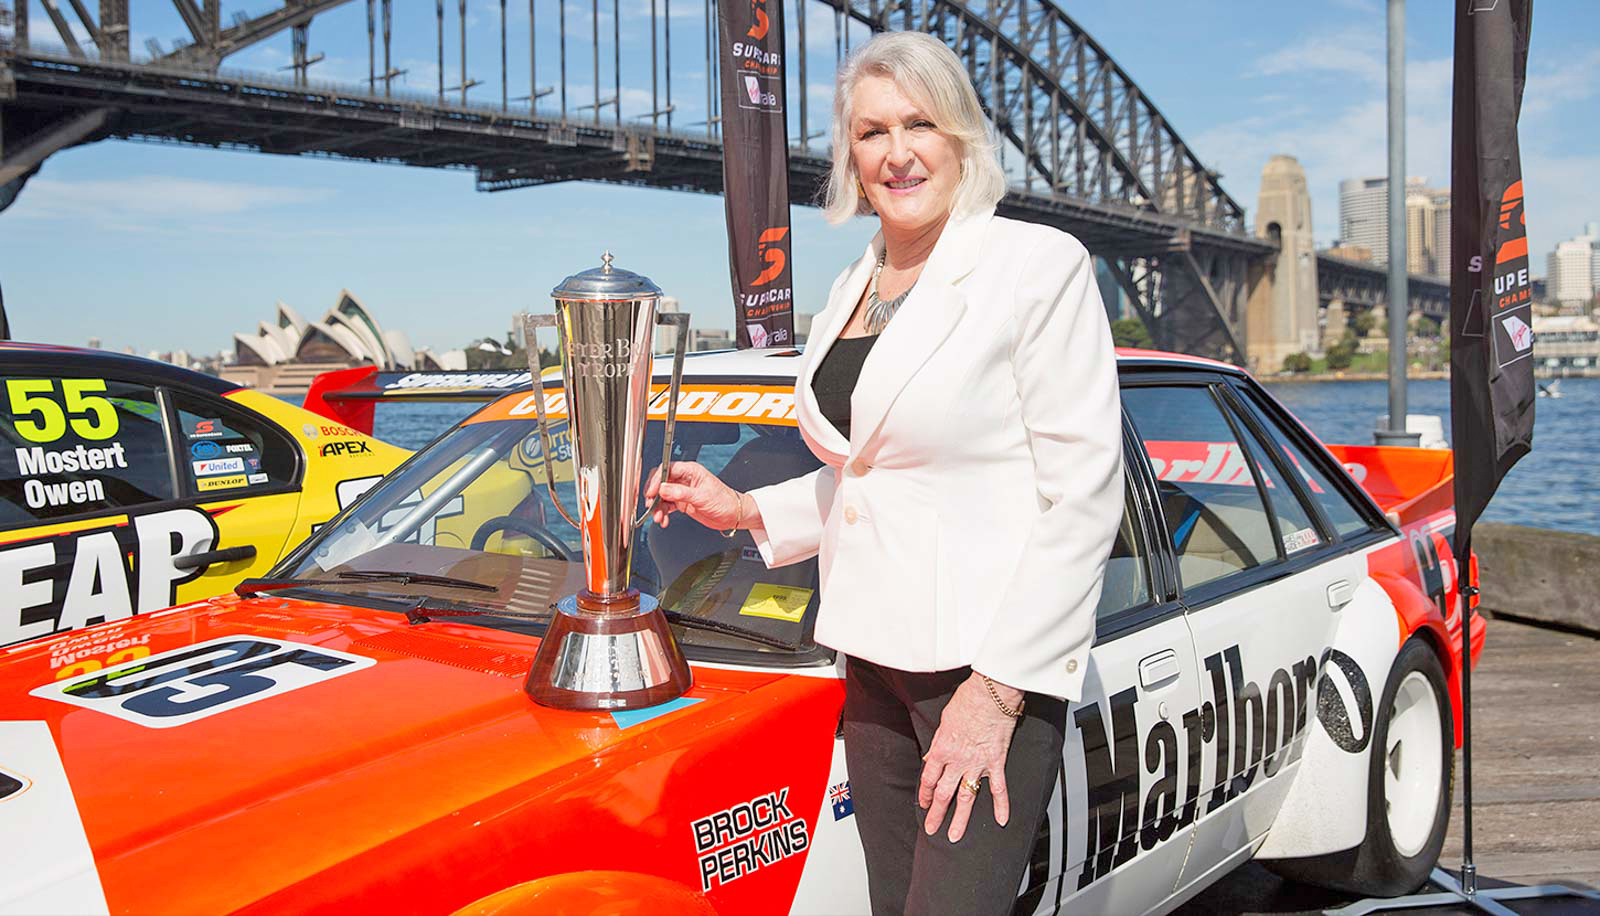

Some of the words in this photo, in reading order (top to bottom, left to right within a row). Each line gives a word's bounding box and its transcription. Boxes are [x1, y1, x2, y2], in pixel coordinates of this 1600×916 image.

[5, 378, 119, 443] 55
[15, 442, 128, 476] Mostert
[207, 478, 244, 487] DUNLOP
[208, 462, 238, 472] United
[24, 478, 105, 509] Owen
[1073, 644, 1372, 892] Marlboro
[692, 786, 794, 854] BROCK
[698, 818, 808, 893] PERKINS
